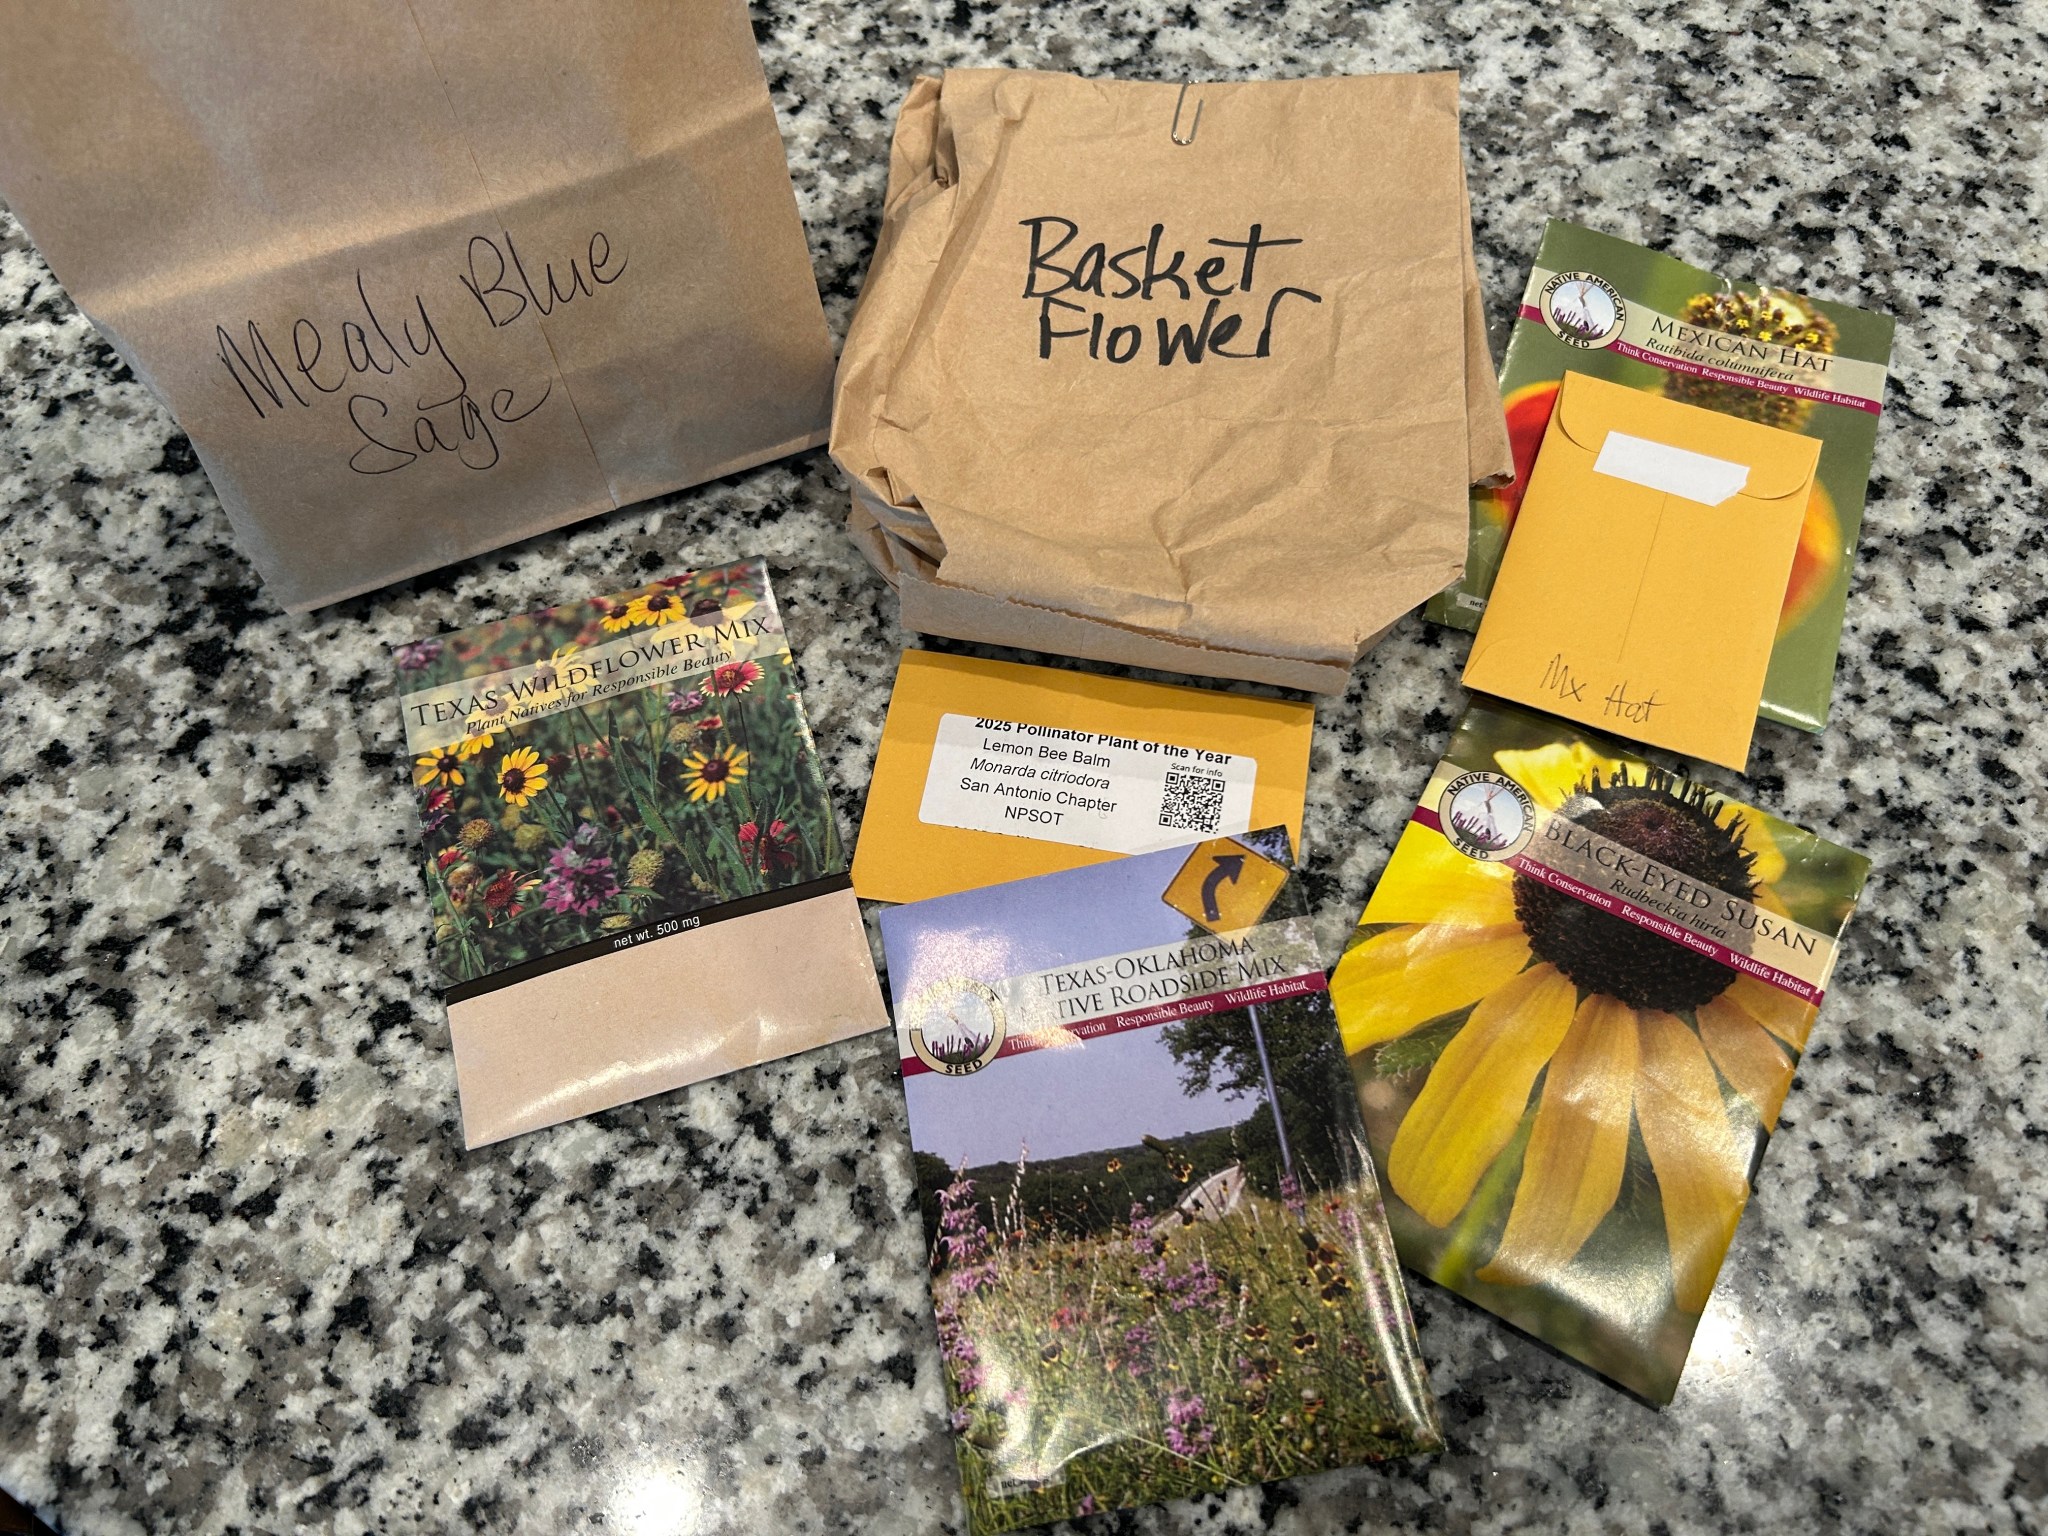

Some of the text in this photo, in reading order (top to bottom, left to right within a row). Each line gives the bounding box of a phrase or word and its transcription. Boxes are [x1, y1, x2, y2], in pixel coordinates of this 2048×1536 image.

[1019, 216, 1304, 300] Basket
[216, 230, 630, 419] Mealy Blue
[1545, 272, 1625, 321] NATIVE AMERICAN
[1038, 287, 1322, 366] Flower
[1557, 330, 1590, 348] SEED
[1645, 337, 1705, 362] Ratibida
[1651, 315, 1834, 372] MEXICAN HAT
[1616, 341, 1866, 408] Think Conservation Responsible Beauty Wildlife Habitat
[349, 377, 553, 474] Sage
[1469, 600, 1483, 608] net
[410, 616, 772, 726] TEXAS WILDFLOWER MIX
[466, 649, 732, 735] Plant Natives for Responsible Beauty
[1539, 653, 1667, 723] Mx Hat
[975, 717, 1232, 765] 2025 Pollinator Plant of the Year
[982, 737, 1111, 768] Lemon Bee Balm
[960, 777, 1117, 813] San Antonio Chapter
[970, 757, 1110, 790] Monarda citriodora
[1171, 762, 1223, 778] Scan for info
[1004, 805, 1064, 826] NPSOT
[1447, 772, 1534, 833] NATIVE AMERICAN
[1453, 838, 1489, 860] SEED
[1544, 818, 1817, 956] BLACK-EYED SUSAN
[1609, 878, 1727, 940] Rudbeckia hirta
[614, 916, 700, 948] net wt. 500 mg
[1518, 858, 1811, 997] Think Conservation Responsible Beauty Wildlife Habitat
[1040, 936, 1256, 995] TEXAS-OKLAHOMA
[1110, 966, 1231, 1008] ROADSIDE
[1237, 955, 1287, 982] MIX
[1008, 1034, 1041, 1051] Thin
[1116, 1006, 1178, 1028] Responsible
[1179, 1000, 1215, 1015] Beauty
[1224, 988, 1267, 1005] Wildlife
[1268, 979, 1307, 996] Habitat
[944, 1059, 983, 1075] SEED
